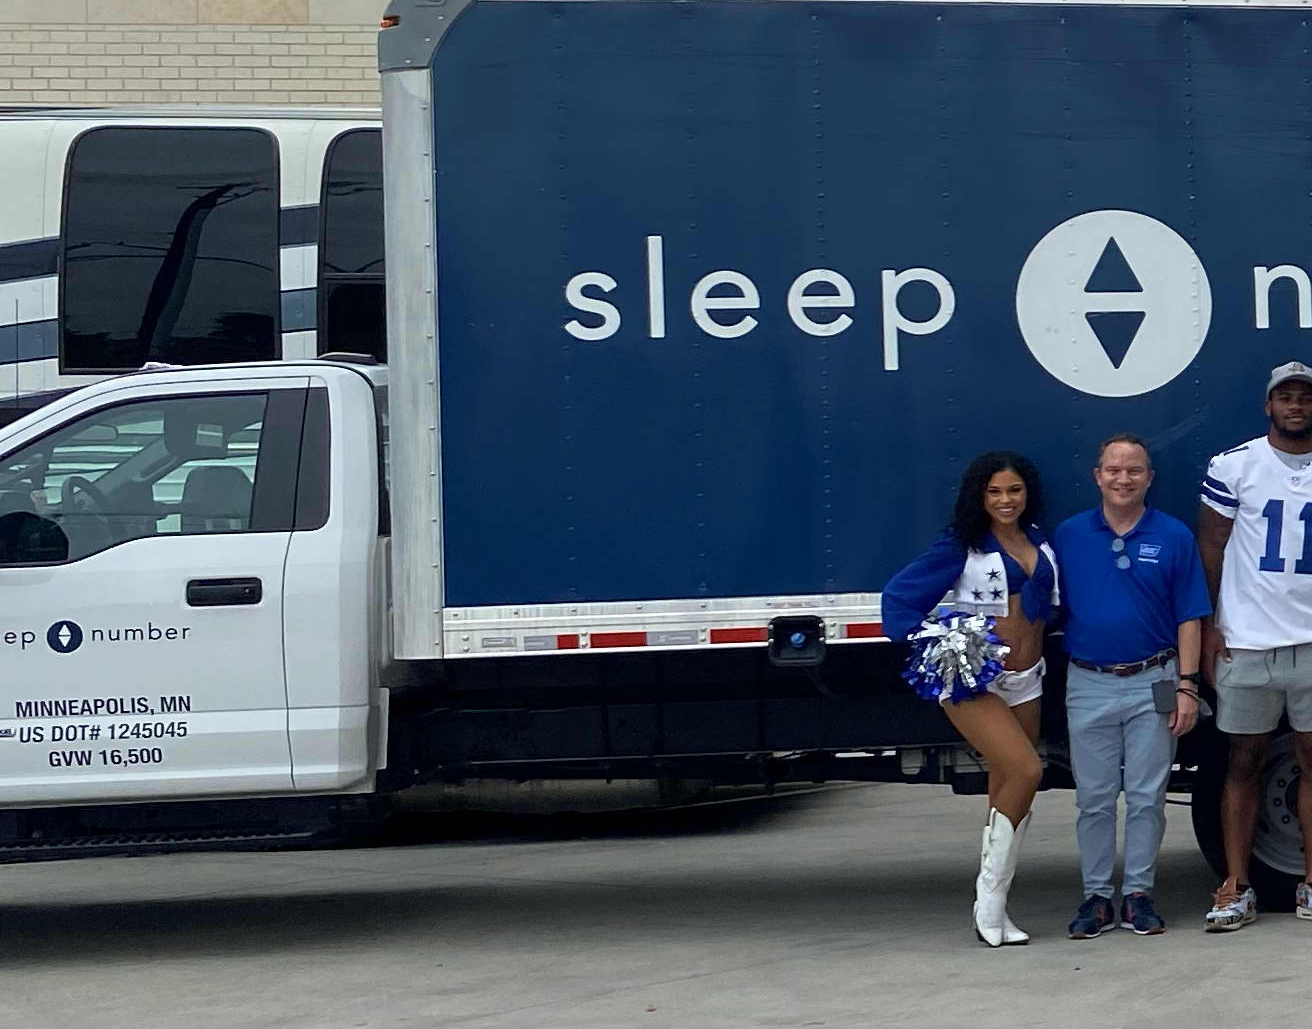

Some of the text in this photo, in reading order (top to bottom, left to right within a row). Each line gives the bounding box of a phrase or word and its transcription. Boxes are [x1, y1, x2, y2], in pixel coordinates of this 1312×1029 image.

[563, 234, 956, 371] sleep
[90, 621, 191, 642] number
[15, 695, 192, 718] MINNEAPOLIS, MN
[19, 726, 45, 743] US
[51, 724, 101, 742] DOT#
[107, 721, 188, 740] 1245045
[48, 747, 163, 768] GVW 16,500
